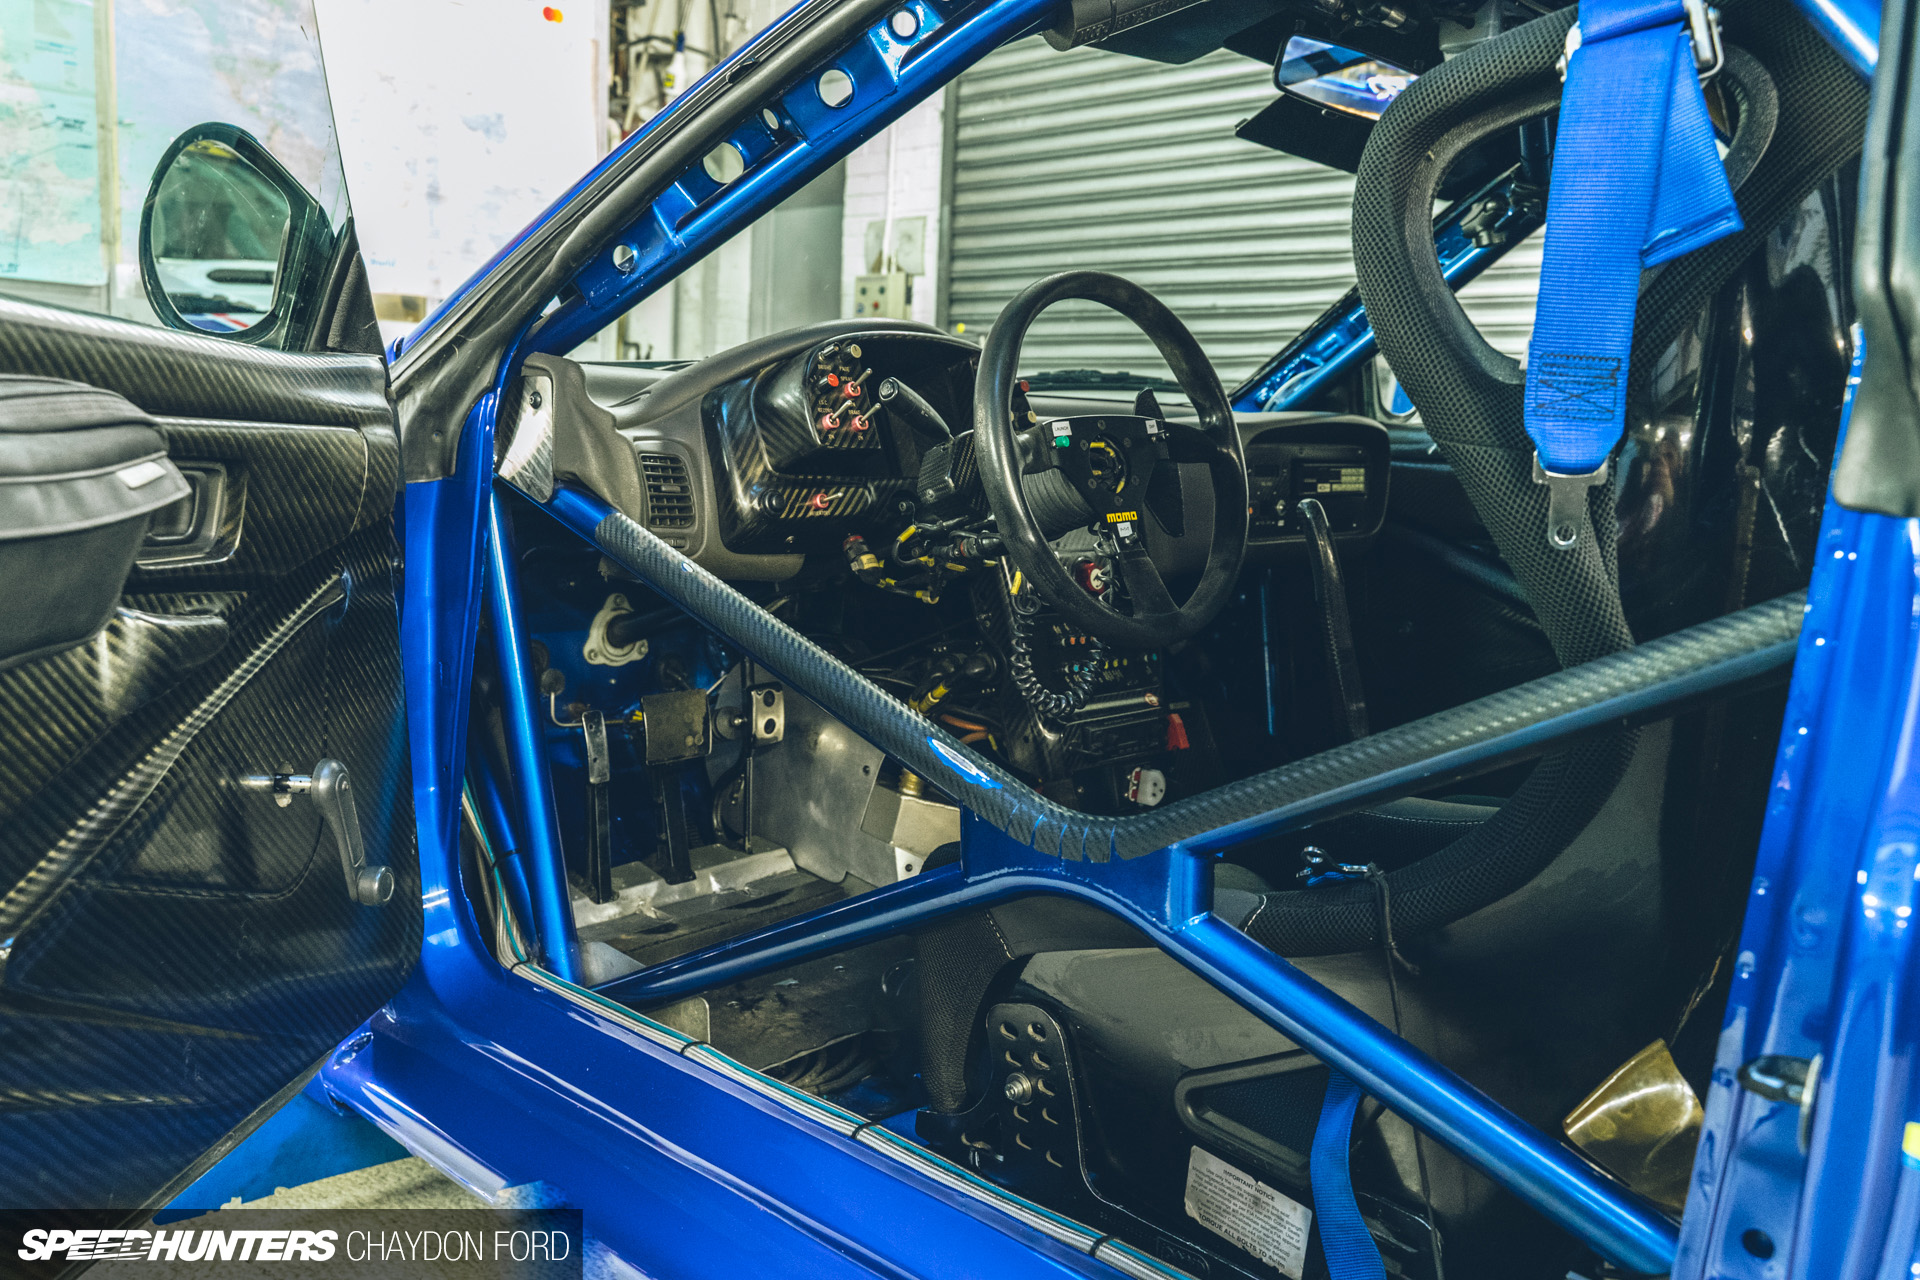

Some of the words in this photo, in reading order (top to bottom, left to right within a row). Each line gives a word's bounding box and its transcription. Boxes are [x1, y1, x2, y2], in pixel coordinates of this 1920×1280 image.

[1223, 1168, 1252, 1189] IMPORTANT
[1255, 1186, 1274, 1202] NOTICE
[1224, 1228, 1235, 1238] ALL
